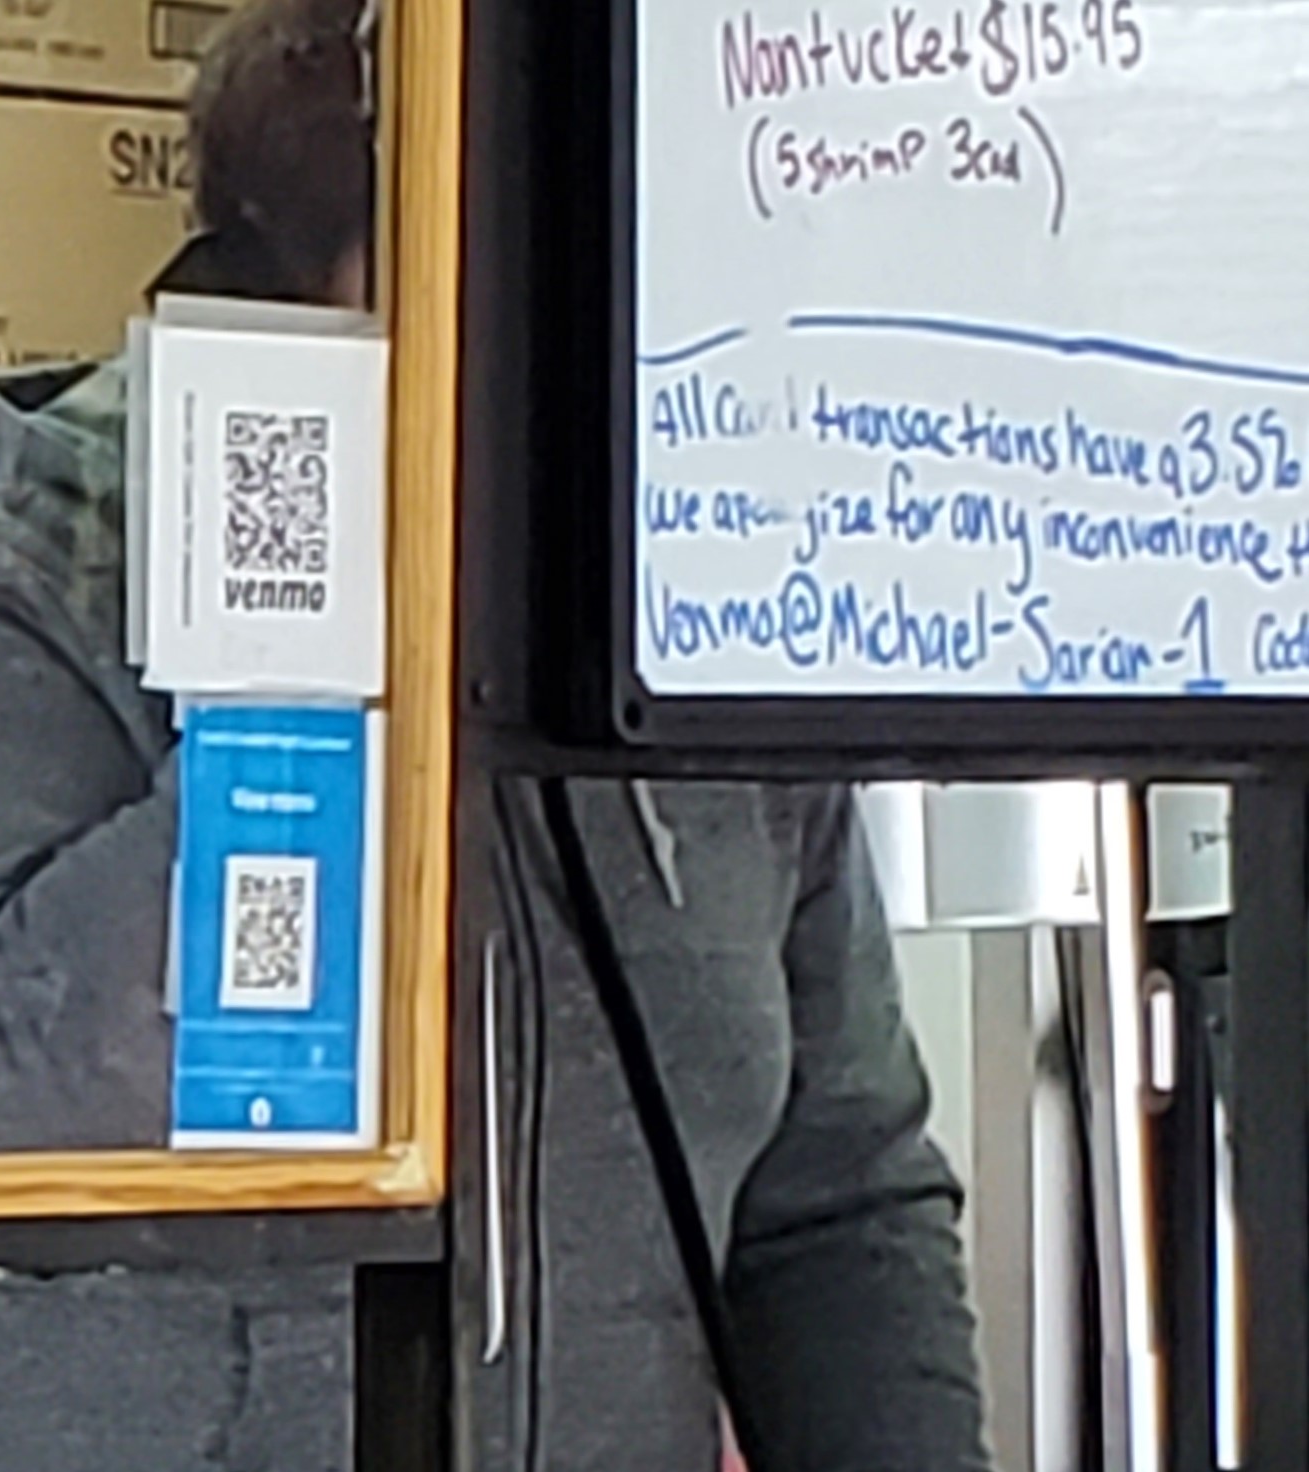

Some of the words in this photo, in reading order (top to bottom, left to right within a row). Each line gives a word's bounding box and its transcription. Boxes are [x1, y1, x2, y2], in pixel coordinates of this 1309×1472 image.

[723, 6, 972, 108] Nantucket
[979, 0, 1142, 96] $15.95
[654, 372, 708, 448] All
[714, 384, 798, 438] Ca
[812, 383, 1059, 475] transactions
[1066, 405, 1150, 486] have
[886, 460, 947, 542] for
[951, 492, 1032, 596] any
[223, 577, 329, 614] venmo
